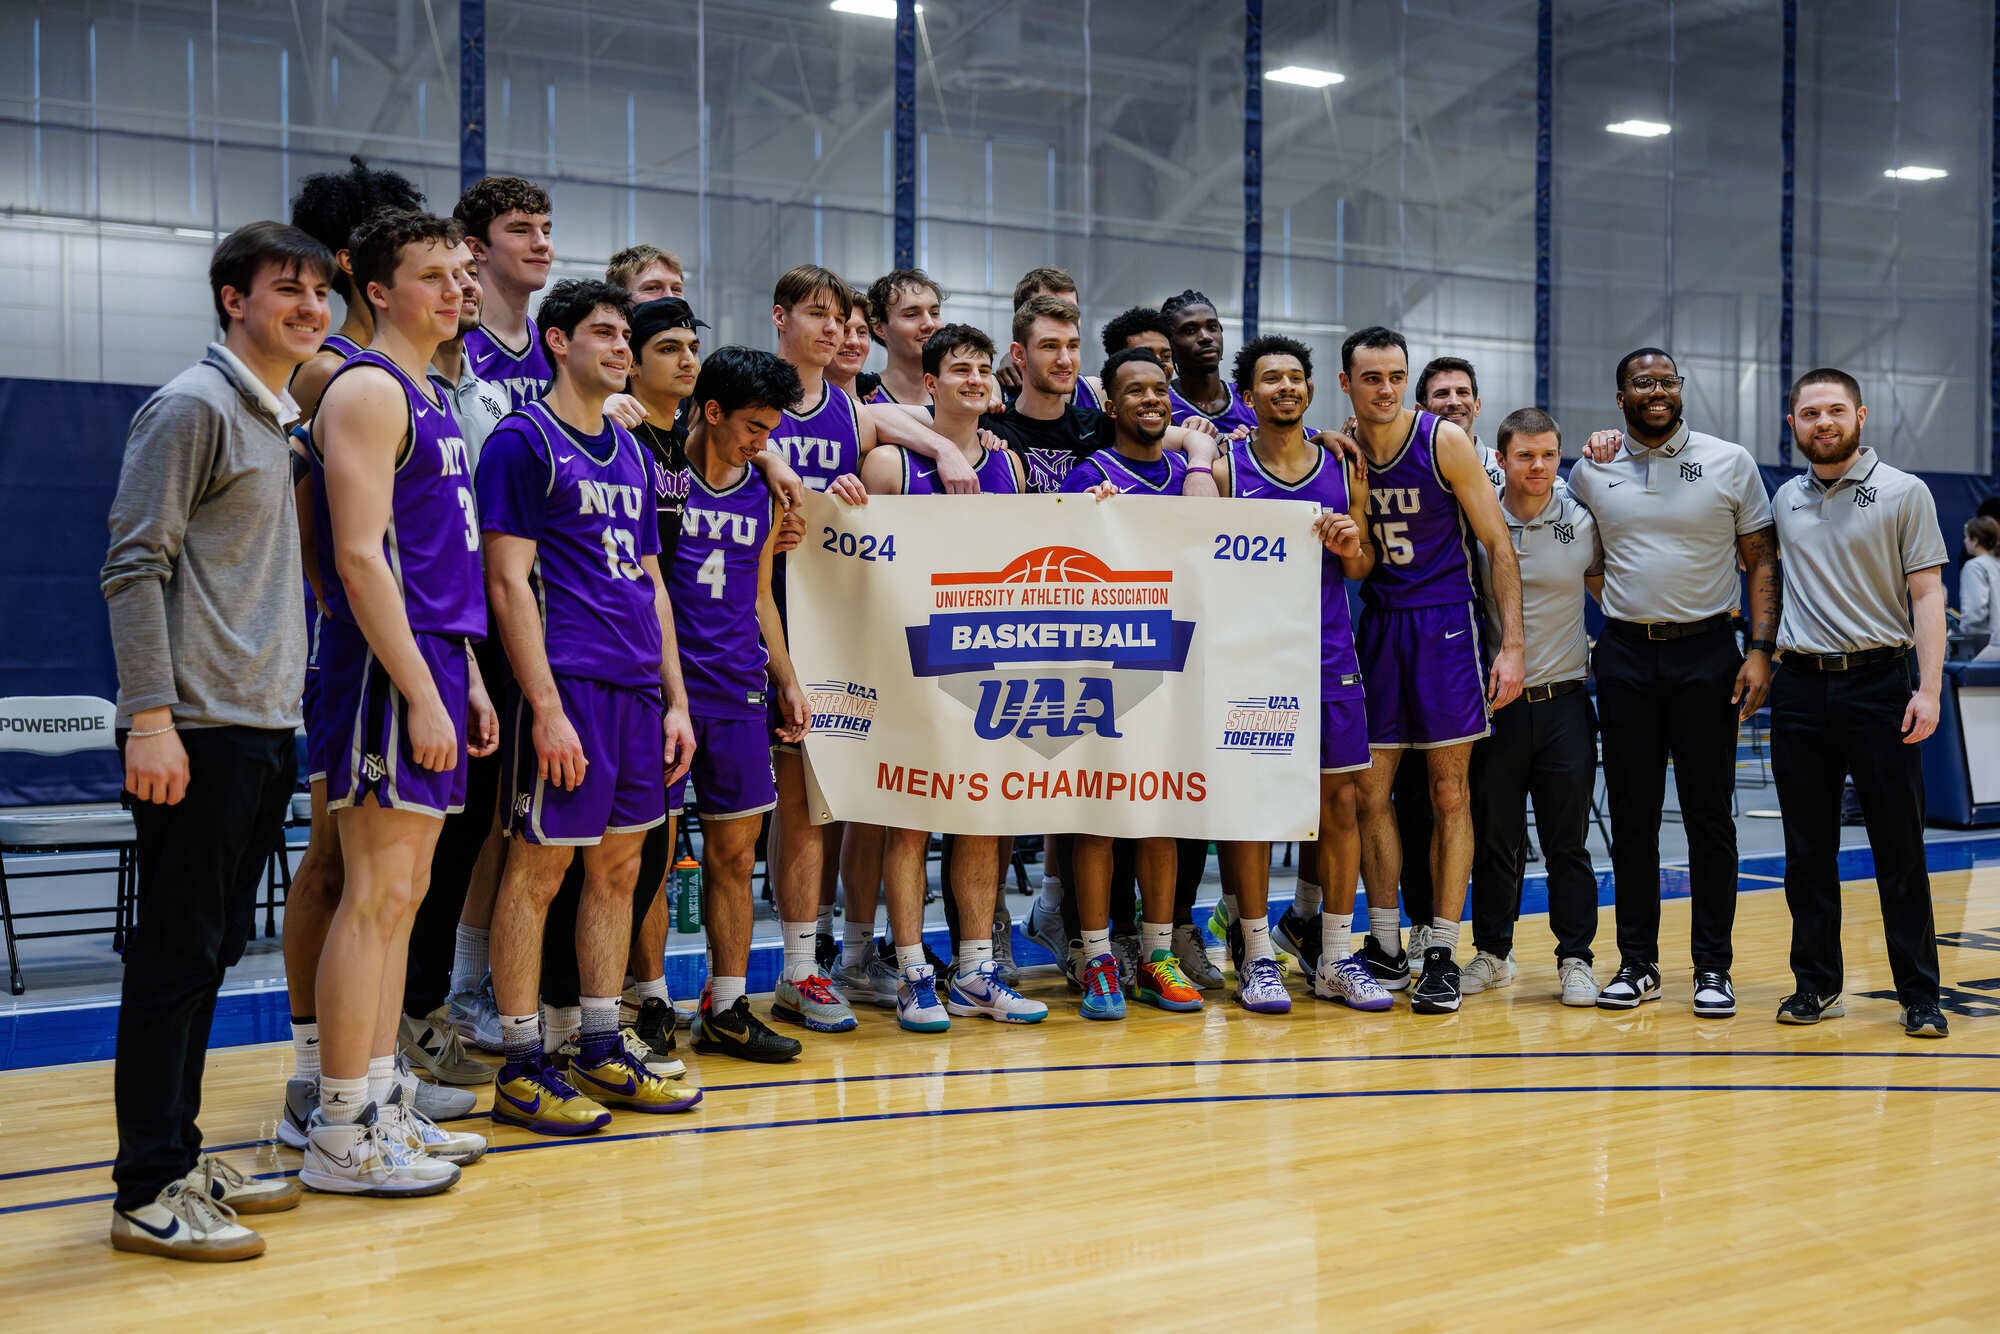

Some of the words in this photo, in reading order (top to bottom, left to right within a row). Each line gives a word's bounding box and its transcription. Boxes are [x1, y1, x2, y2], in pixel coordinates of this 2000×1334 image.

[578, 480, 642, 520] NYU
[457, 486, 480, 552] 3
[680, 507, 758, 546] NYU
[822, 526, 896, 562] 2024
[1213, 533, 1287, 562] 2024
[1373, 521, 1415, 565] 15
[697, 549, 726, 600] 4
[935, 589, 1014, 608] UNIVERSITY
[1021, 588, 1085, 606] ATHLETIC
[1092, 587, 1168, 605] ASSOCIATION
[951, 623, 1156, 650] BASKETBALL
[846, 681, 878, 700] UAA
[1268, 696, 1300, 710] UAA
[807, 692, 878, 719] STRIVE
[974, 677, 1123, 741] UAA
[0, 716, 105, 733] POWERADE
[810, 714, 872, 733] OGETHER
[1225, 709, 1300, 732] STRIVE
[1223, 731, 1295, 746] TOGETHER
[876, 762, 989, 801] MEN'S
[1001, 769, 1207, 802] CHAMPIONS
